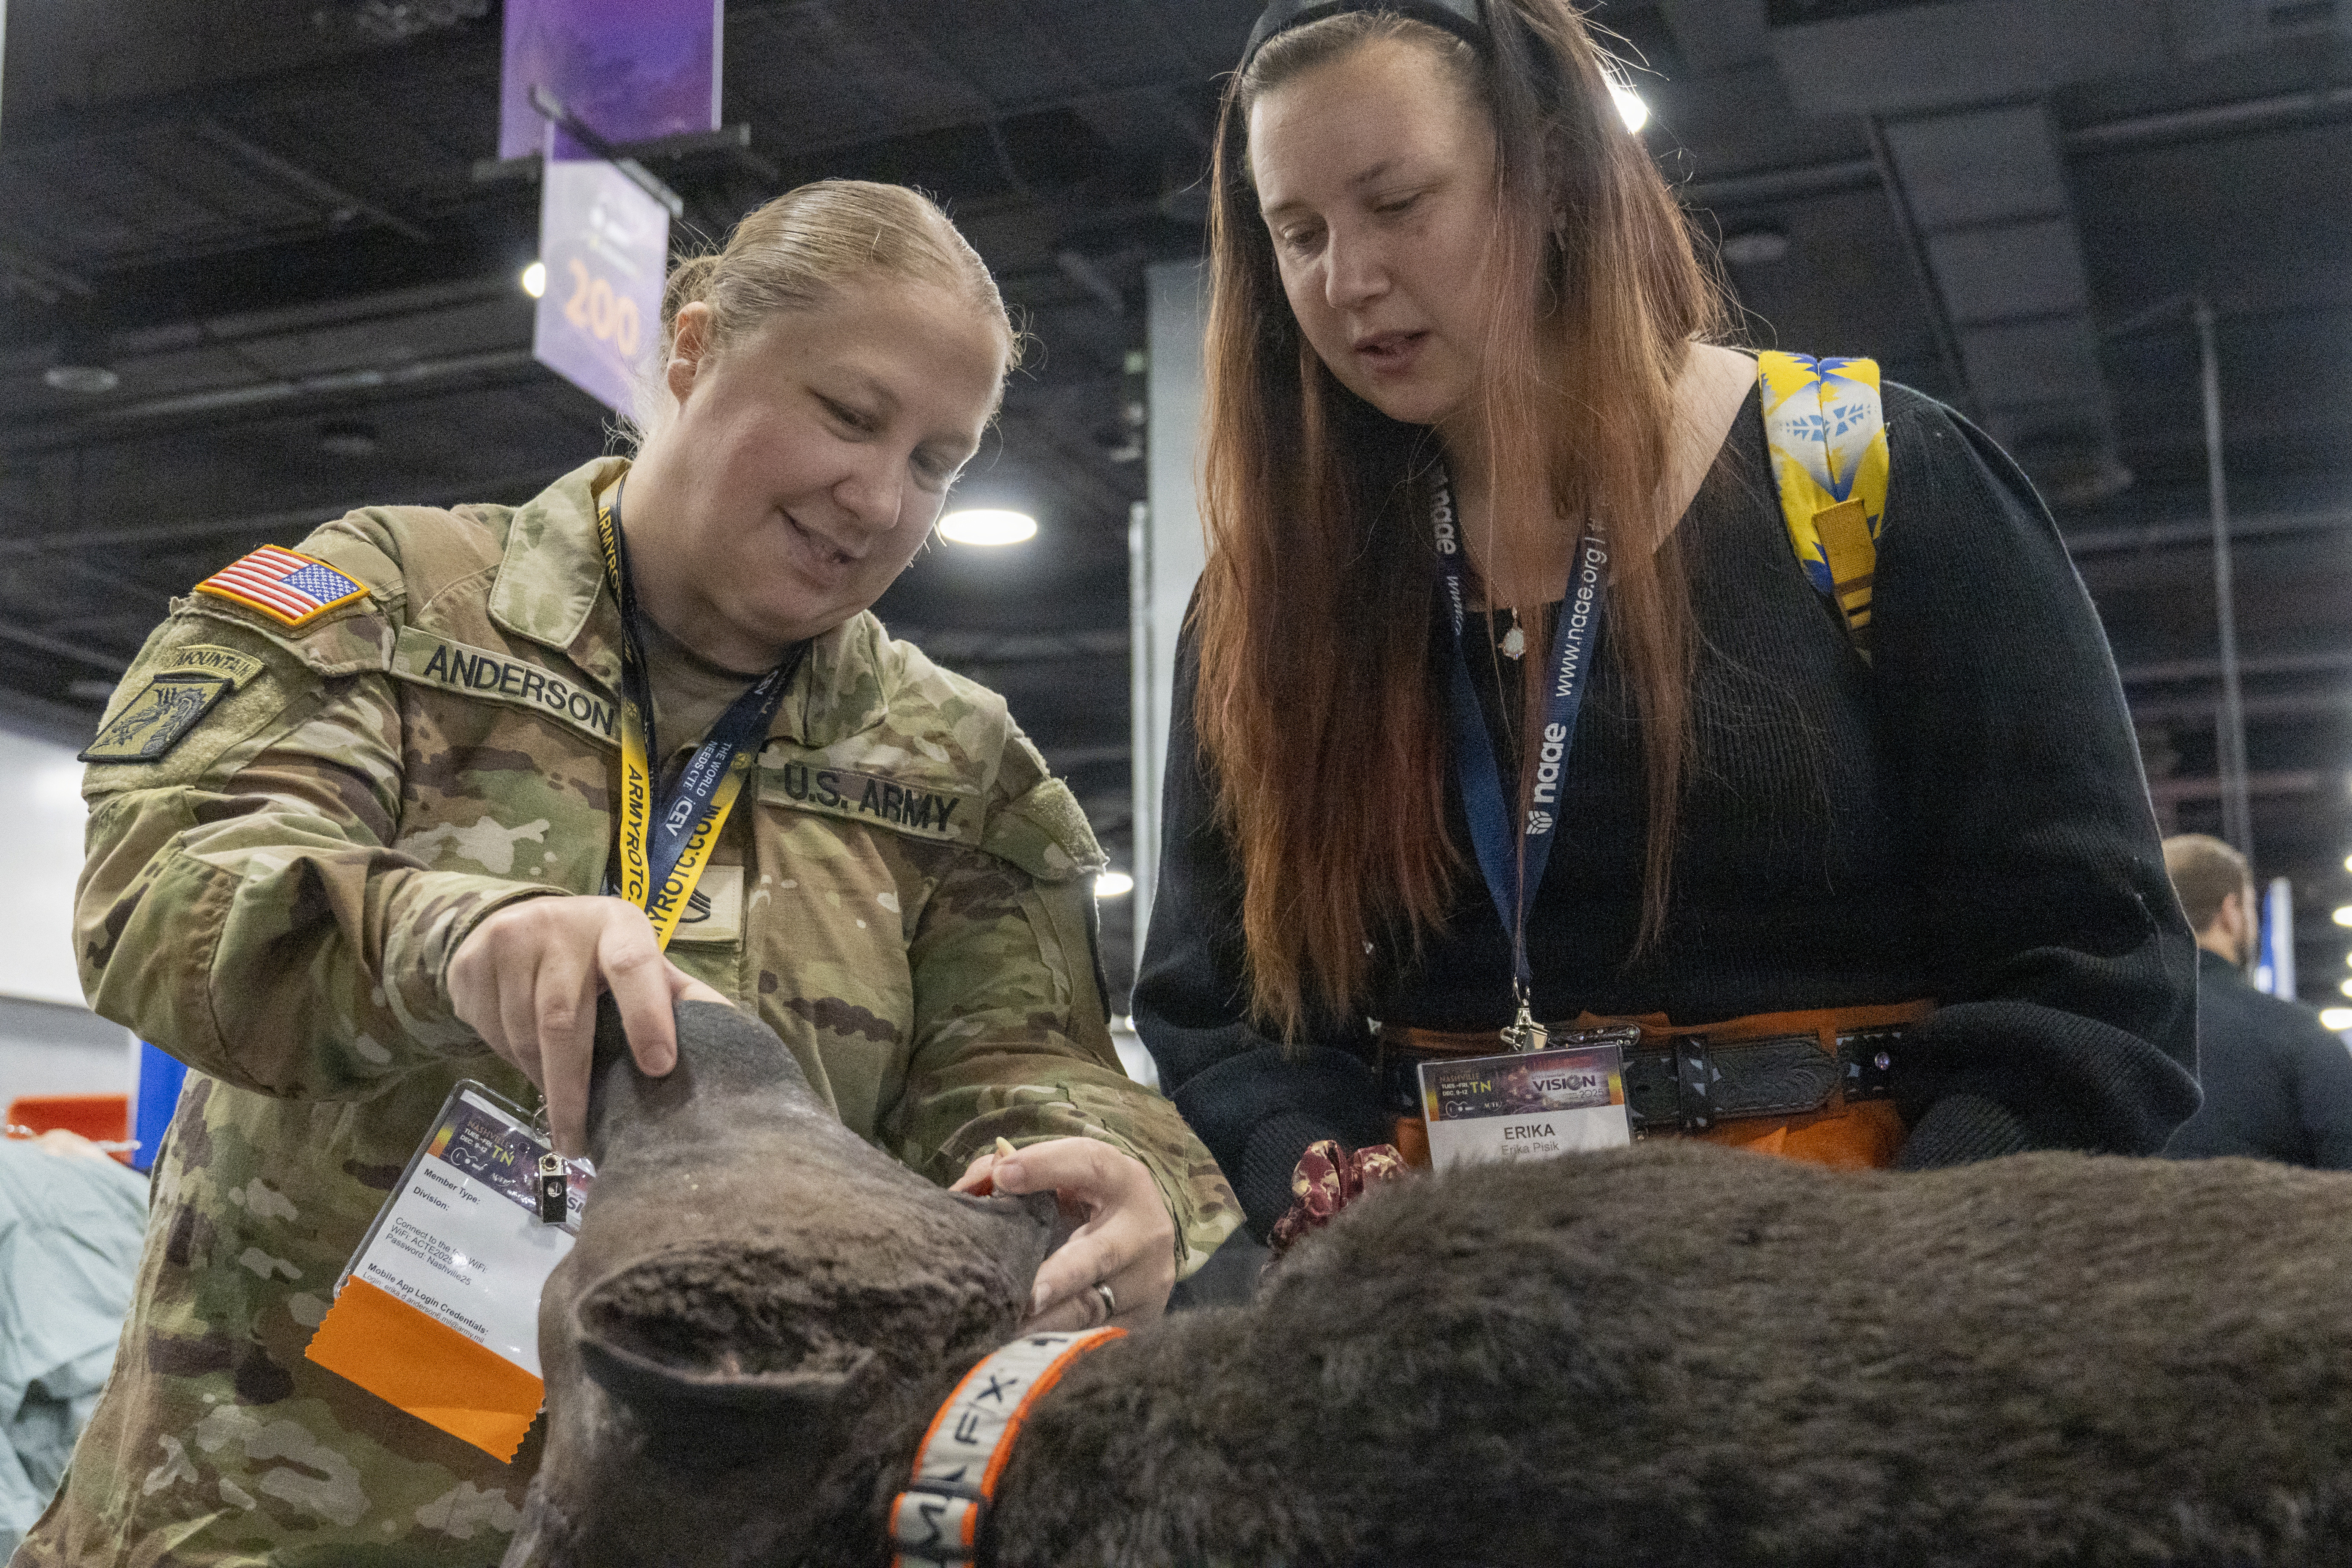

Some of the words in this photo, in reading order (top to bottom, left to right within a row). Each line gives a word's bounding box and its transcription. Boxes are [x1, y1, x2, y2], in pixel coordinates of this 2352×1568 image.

[566, 258, 640, 356] 200
[1556, 549, 1607, 697] www.naae.org
[171, 650, 251, 678] MOUNTAIN
[423, 644, 614, 735] ANDERSON
[694, 740, 718, 770] NEEDS
[716, 742, 732, 760] THE
[1534, 723, 1567, 803] naae
[683, 770, 700, 790] CTE
[697, 760, 721, 797] WORLD
[784, 763, 848, 809] U.S.
[858, 778, 960, 832] ARMY
[1470, 1080, 1491, 1094] TN
[1532, 1074, 1596, 1092] VISION
[1580, 1088, 1604, 1098] 2025
[468, 1120, 510, 1148] NASHVILLE
[1504, 1123, 1555, 1140] ERIKA
[474, 1143, 487, 1152] 9-12
[490, 1145, 514, 1165] TN
[1501, 1142, 1529, 1156] Erika
[1532, 1140, 1559, 1153] Pisik
[413, 1186, 450, 1211] Division:
[424, 1168, 458, 1191] Member
[458, 1187, 481, 1205] Type:
[390, 1224, 412, 1240] WiFi:
[411, 1236, 454, 1264] ACTE2025
[395, 1216, 428, 1239] Connect
[428, 1236, 437, 1244] to
[437, 1240, 451, 1252] the
[468, 1257, 488, 1273] WiFi:
[385, 1233, 426, 1260] Password:
[426, 1256, 472, 1285] Nashville25
[362, 1272, 383, 1287] Login:
[368, 1263, 396, 1282] Mobile
[396, 1279, 415, 1294] App
[414, 1289, 439, 1308] Login
[440, 1303, 489, 1335] Credentials:
